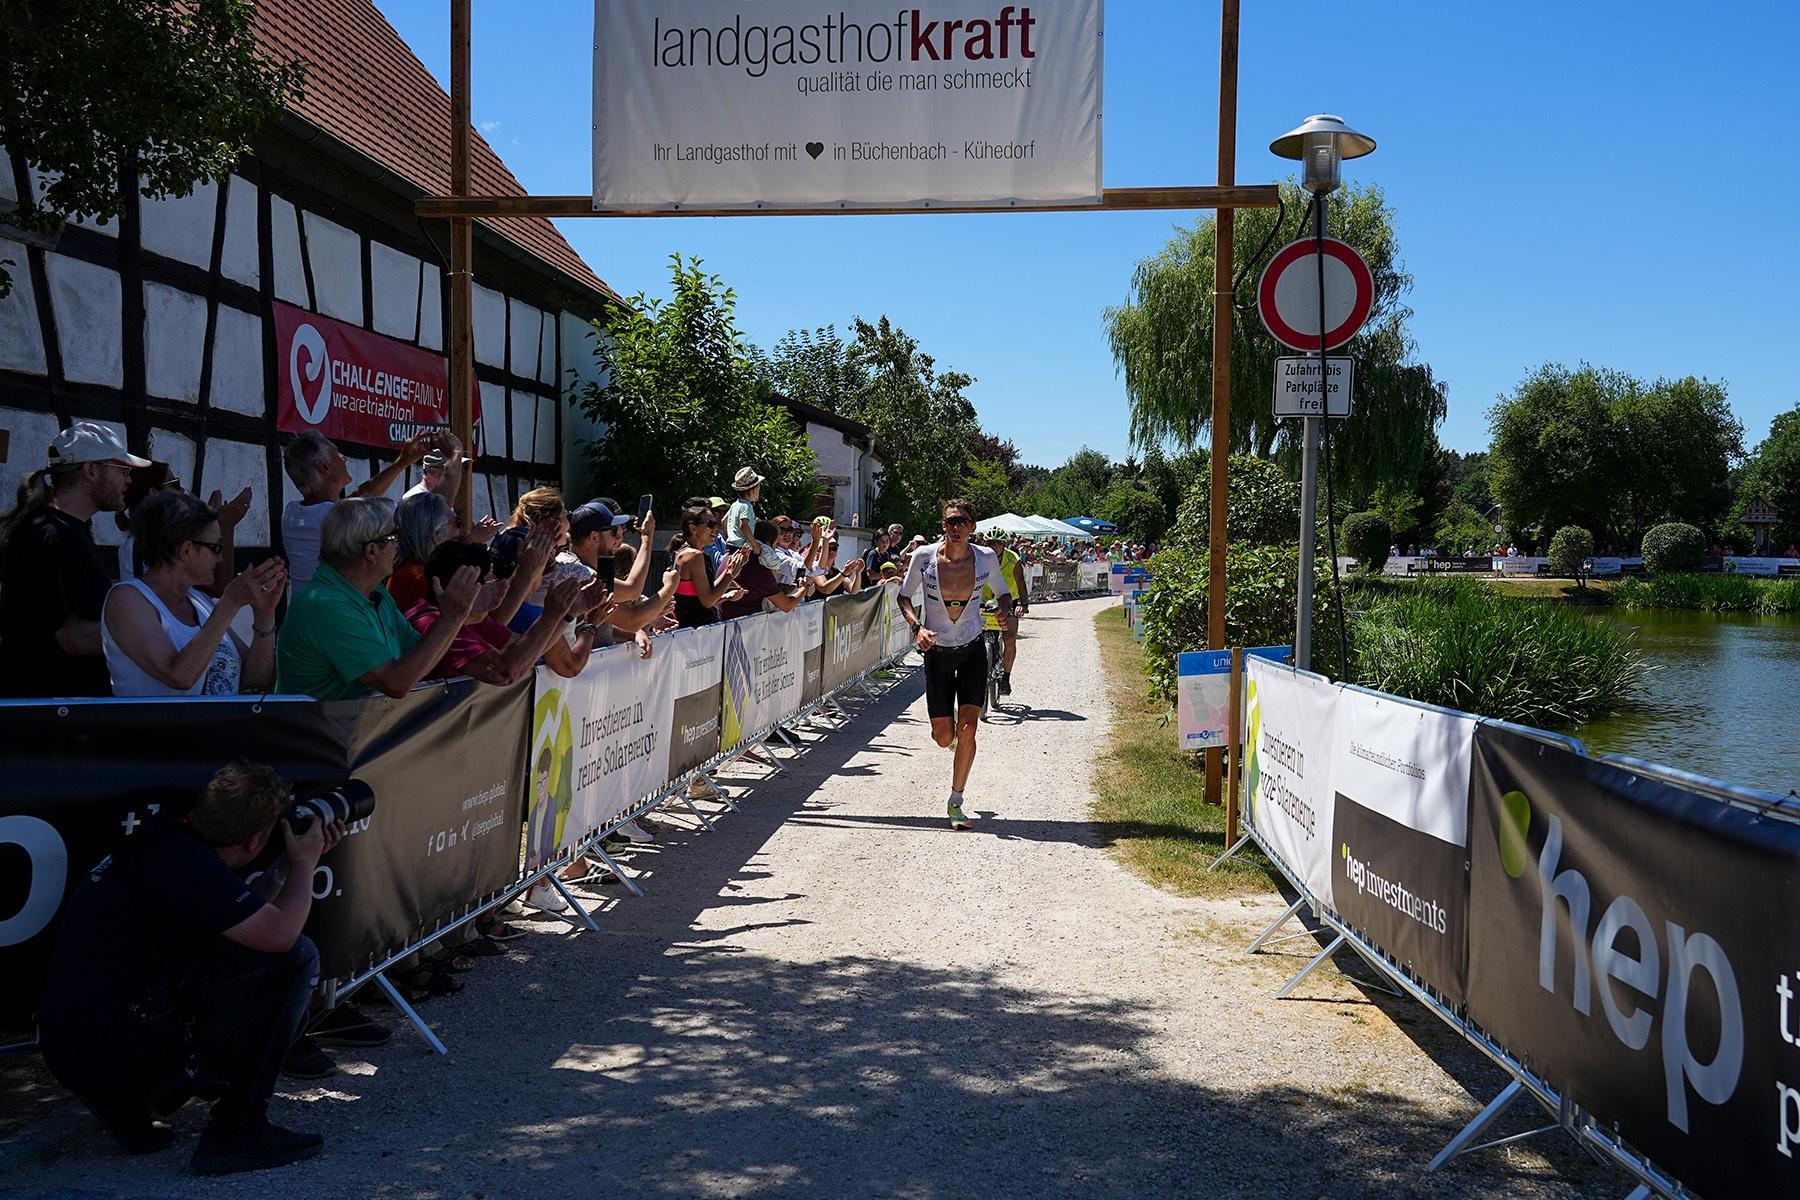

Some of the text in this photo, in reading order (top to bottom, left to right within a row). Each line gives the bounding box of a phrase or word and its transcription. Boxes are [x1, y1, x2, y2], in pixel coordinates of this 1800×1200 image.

[797, 67, 1032, 96] qualität die man schmeckt
[653, 143, 672, 160] Ihr
[677, 143, 770, 164] Landgasthof
[774, 143, 798, 160] mit
[833, 142, 846, 160] in
[851, 141, 946, 160] Büchenbach
[964, 140, 1036, 160] Kühedorf
[1285, 363, 1341, 376] Zufahrt bis
[1286, 381, 1339, 395] Parkpläze
[1299, 398, 1322, 409] frei
[1433, 559, 1451, 570] hep
[833, 616, 851, 671] hep
[580, 695, 643, 749] Investieren in
[684, 725, 695, 746] hep
[577, 753, 601, 791] reine
[1297, 740, 1304, 779] in
[1346, 847, 1446, 934] hep investments
[1538, 813, 1744, 1134] hep
